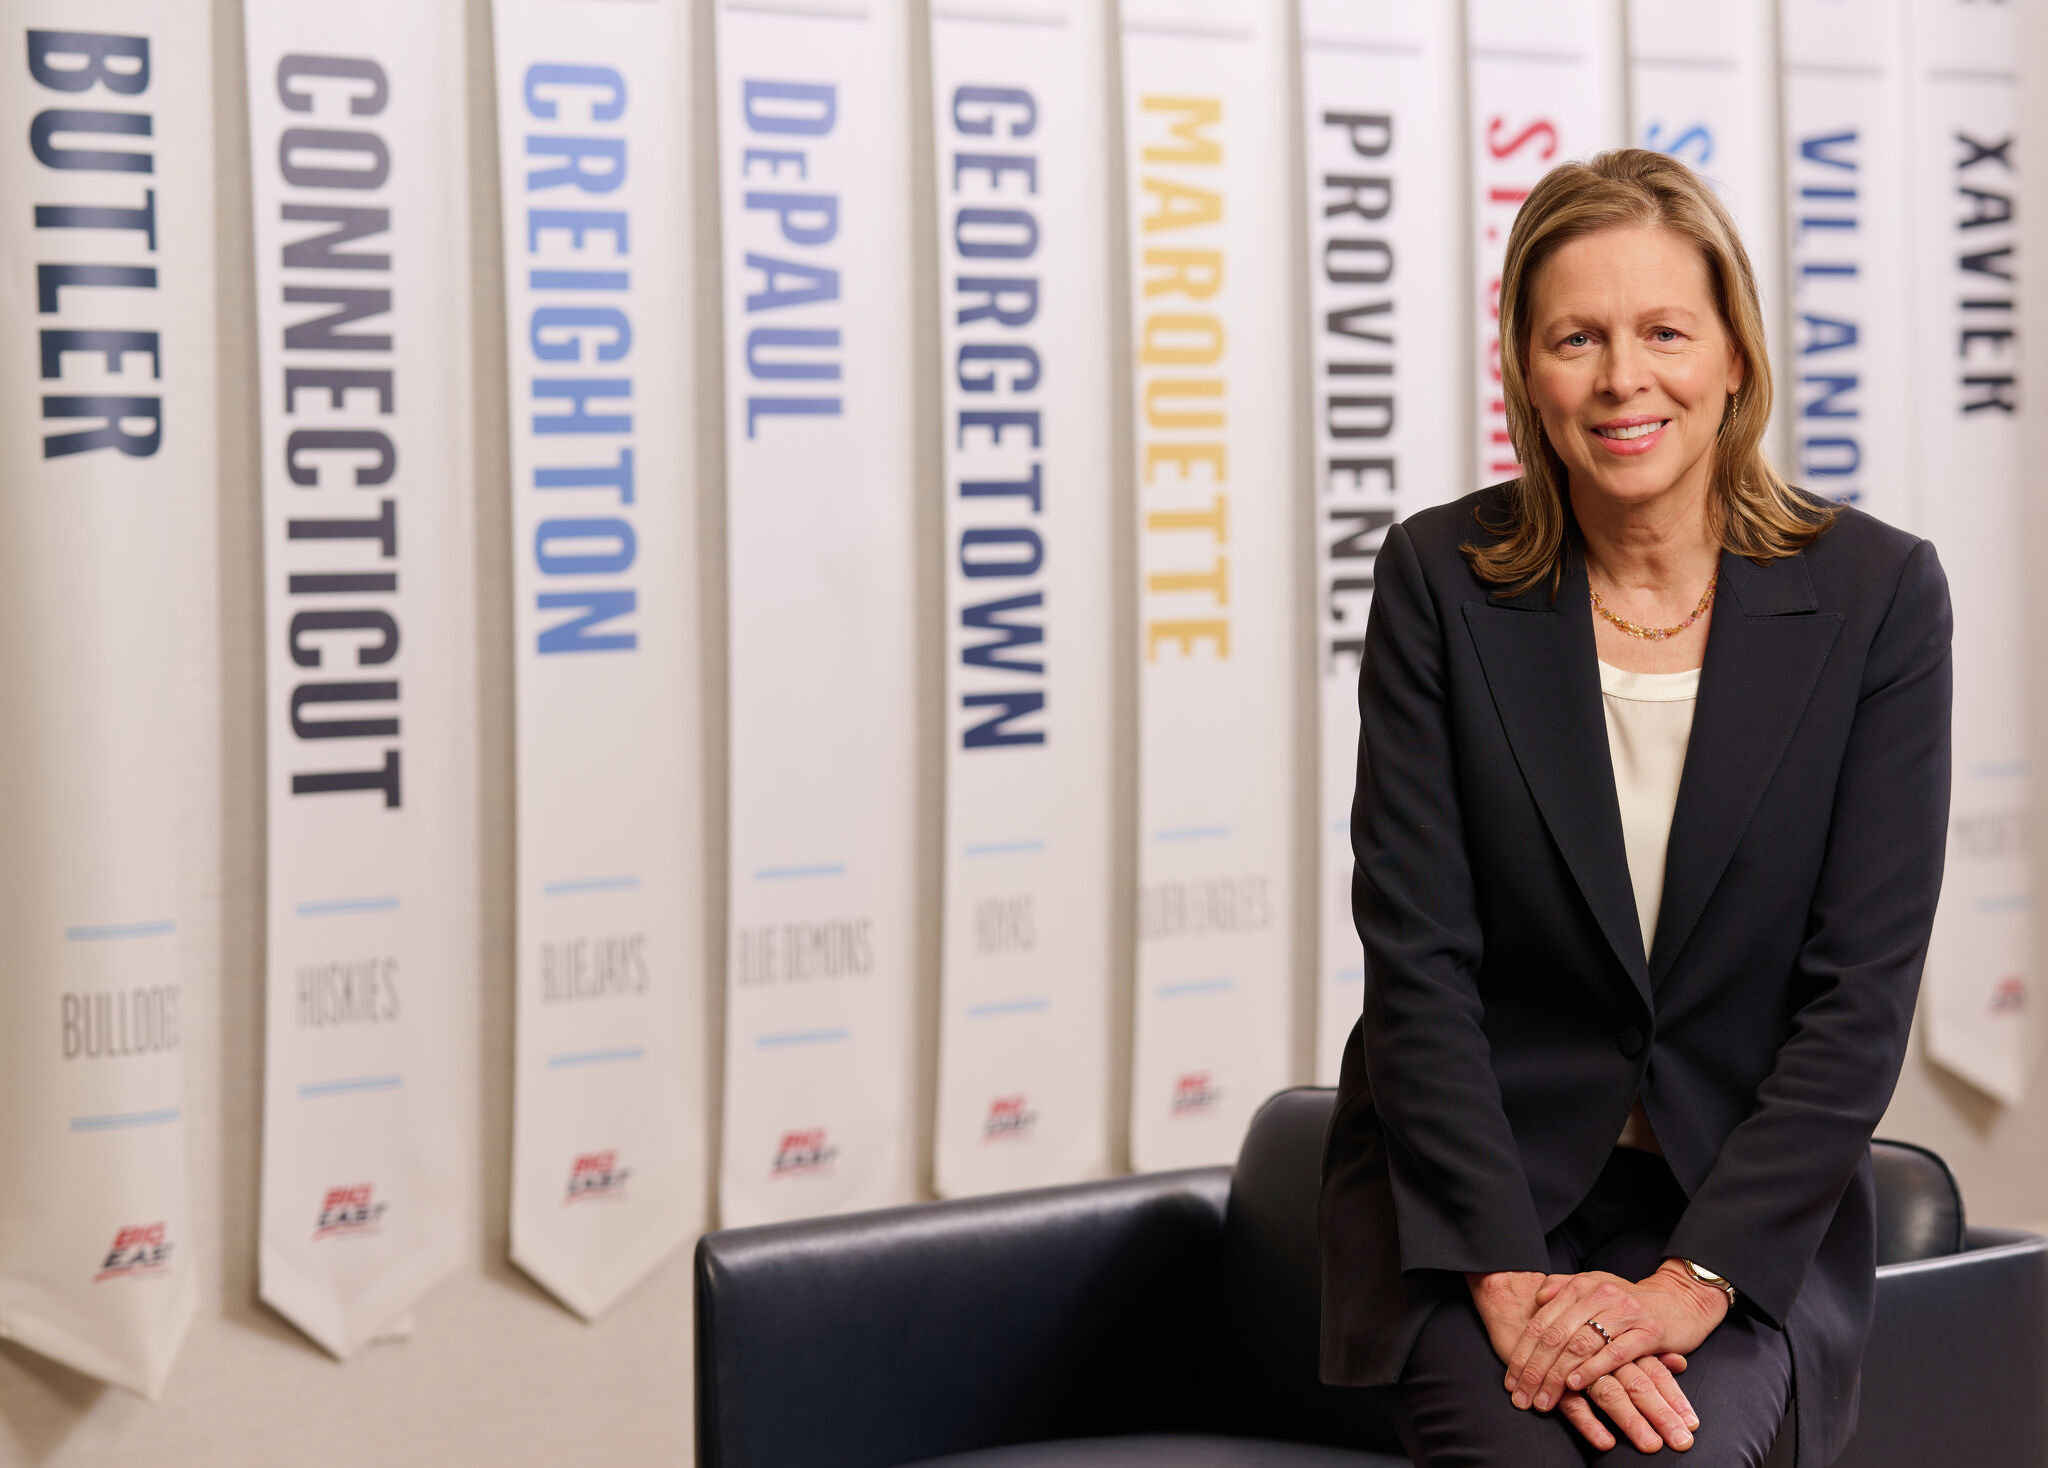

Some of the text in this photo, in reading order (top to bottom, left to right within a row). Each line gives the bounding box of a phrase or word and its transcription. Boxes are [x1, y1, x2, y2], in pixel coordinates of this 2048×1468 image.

[26, 28, 163, 461] BUTLER
[521, 62, 639, 656] CREIGHTON
[951, 84, 1048, 752] GEORGETOWN
[1138, 95, 1231, 664] MARQUETTE
[1797, 131, 1862, 504] VILLANO
[1955, 132, 2019, 415] XAVIER
[276, 53, 404, 811] CONNECTICUT
[295, 957, 402, 1029] HUSKIES
[114, 1221, 166, 1250] BIG
[317, 1201, 388, 1229] EAST
[324, 1182, 376, 1209] BIG
